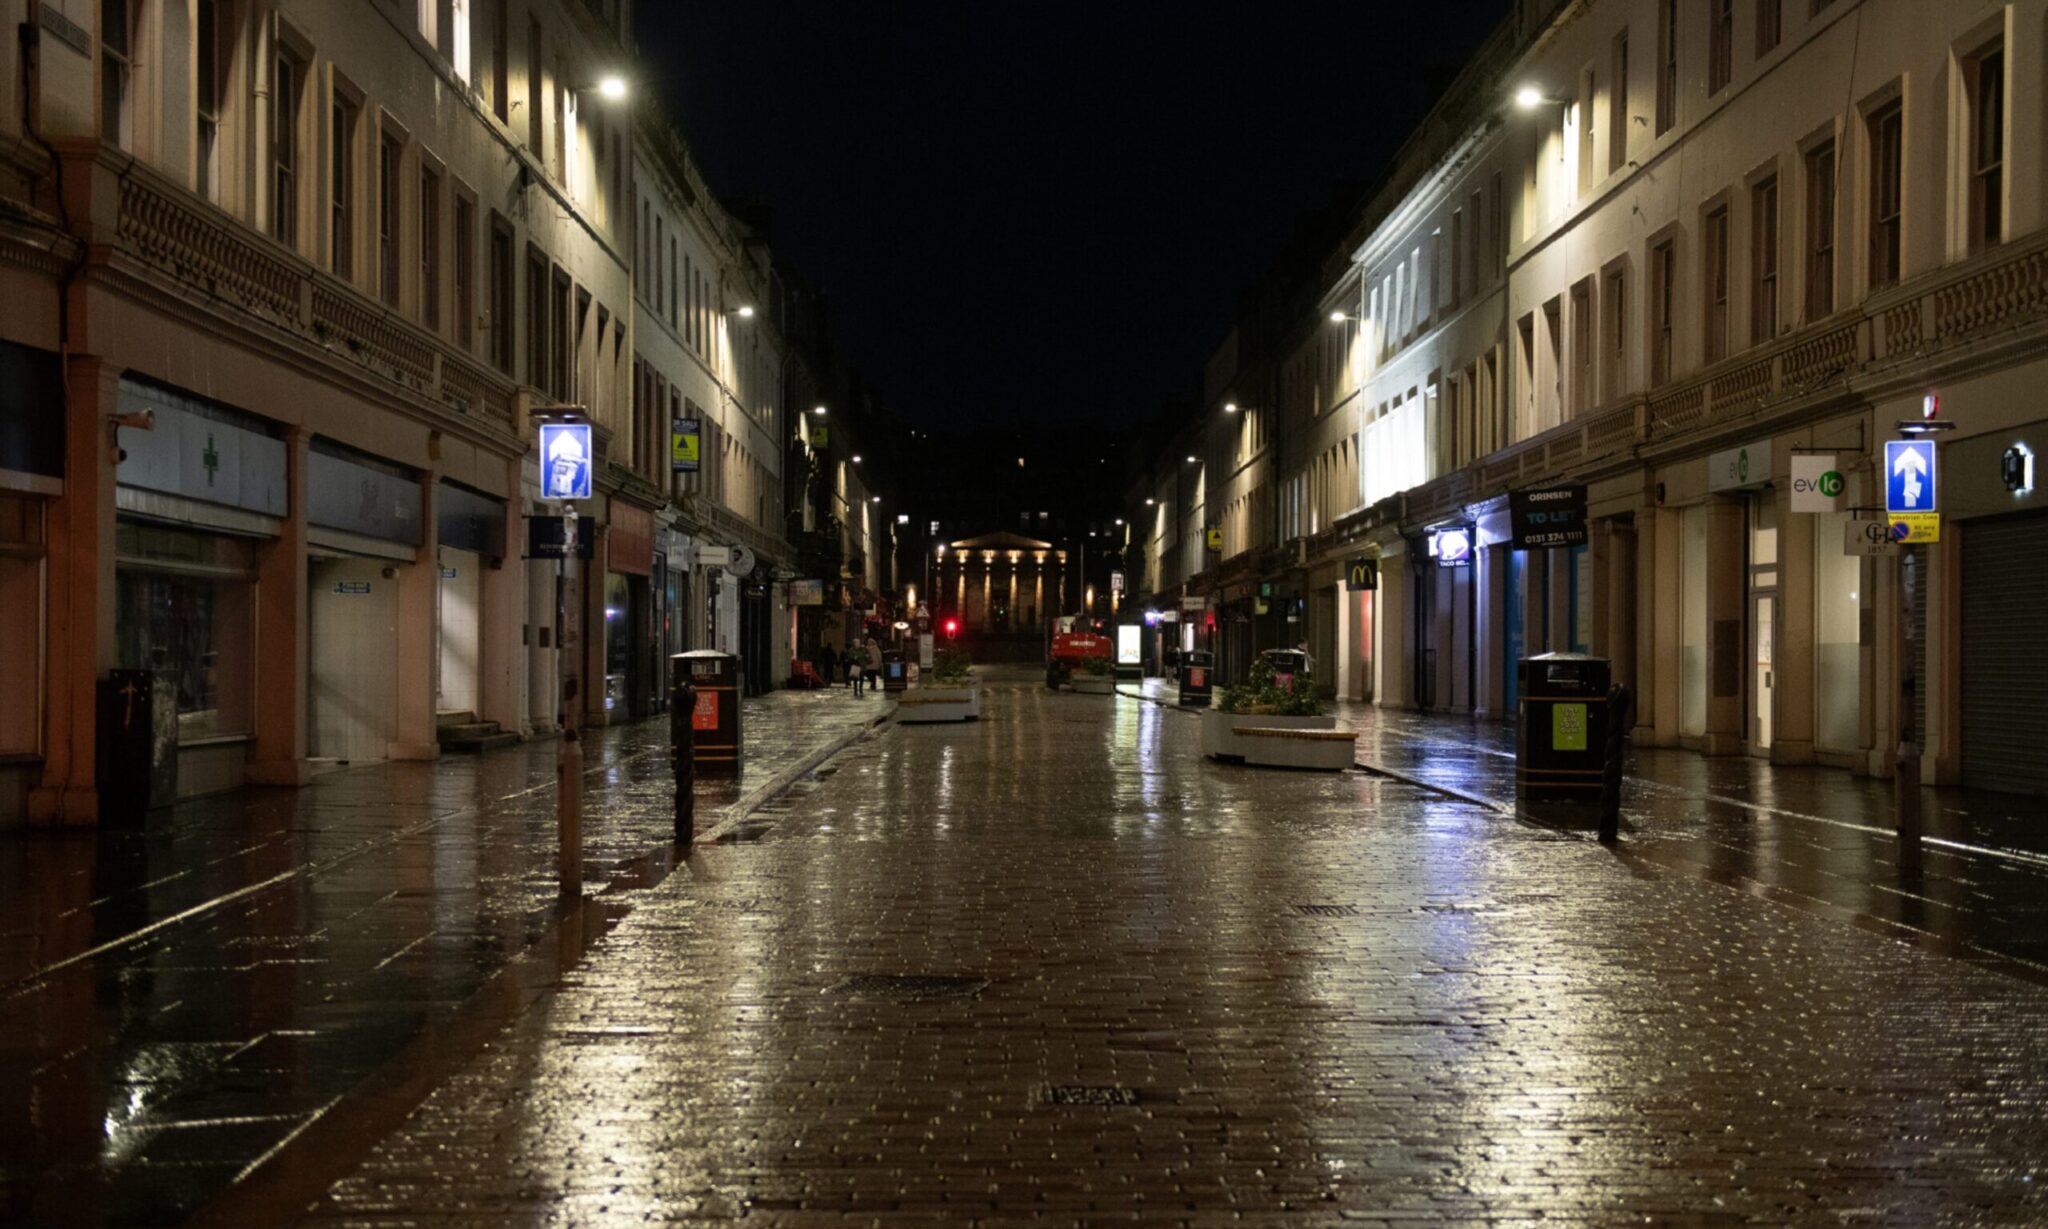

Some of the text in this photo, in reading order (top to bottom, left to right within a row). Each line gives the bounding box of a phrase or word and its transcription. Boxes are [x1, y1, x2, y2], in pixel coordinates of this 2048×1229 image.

[1793, 474, 1843, 494] evlo
[1529, 491, 1572, 502] ORINSEN
[1526, 510, 1577, 525] TO LET
[1525, 534, 1545, 544] 0131
[1547, 532, 1565, 541] 374
